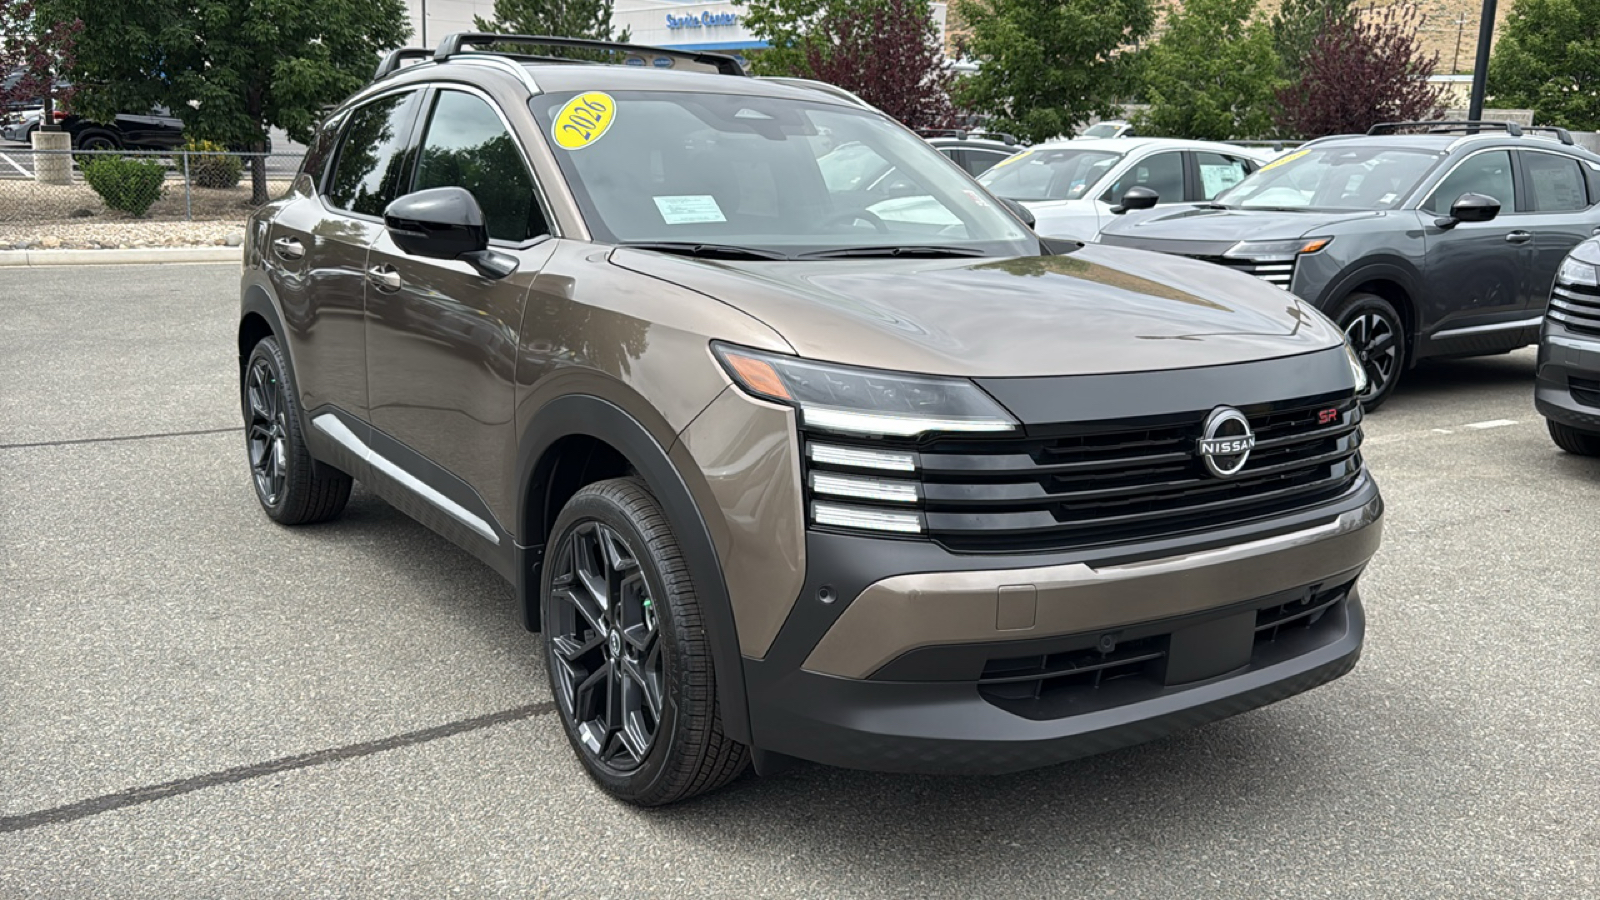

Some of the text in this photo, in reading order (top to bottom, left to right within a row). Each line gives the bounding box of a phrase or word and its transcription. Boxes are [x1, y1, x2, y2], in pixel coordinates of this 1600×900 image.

[666, 11, 737, 29] Service Center
[563, 97, 607, 141] 2026
[1318, 408, 1337, 425] SR
[1202, 436, 1256, 454] NISSAN
